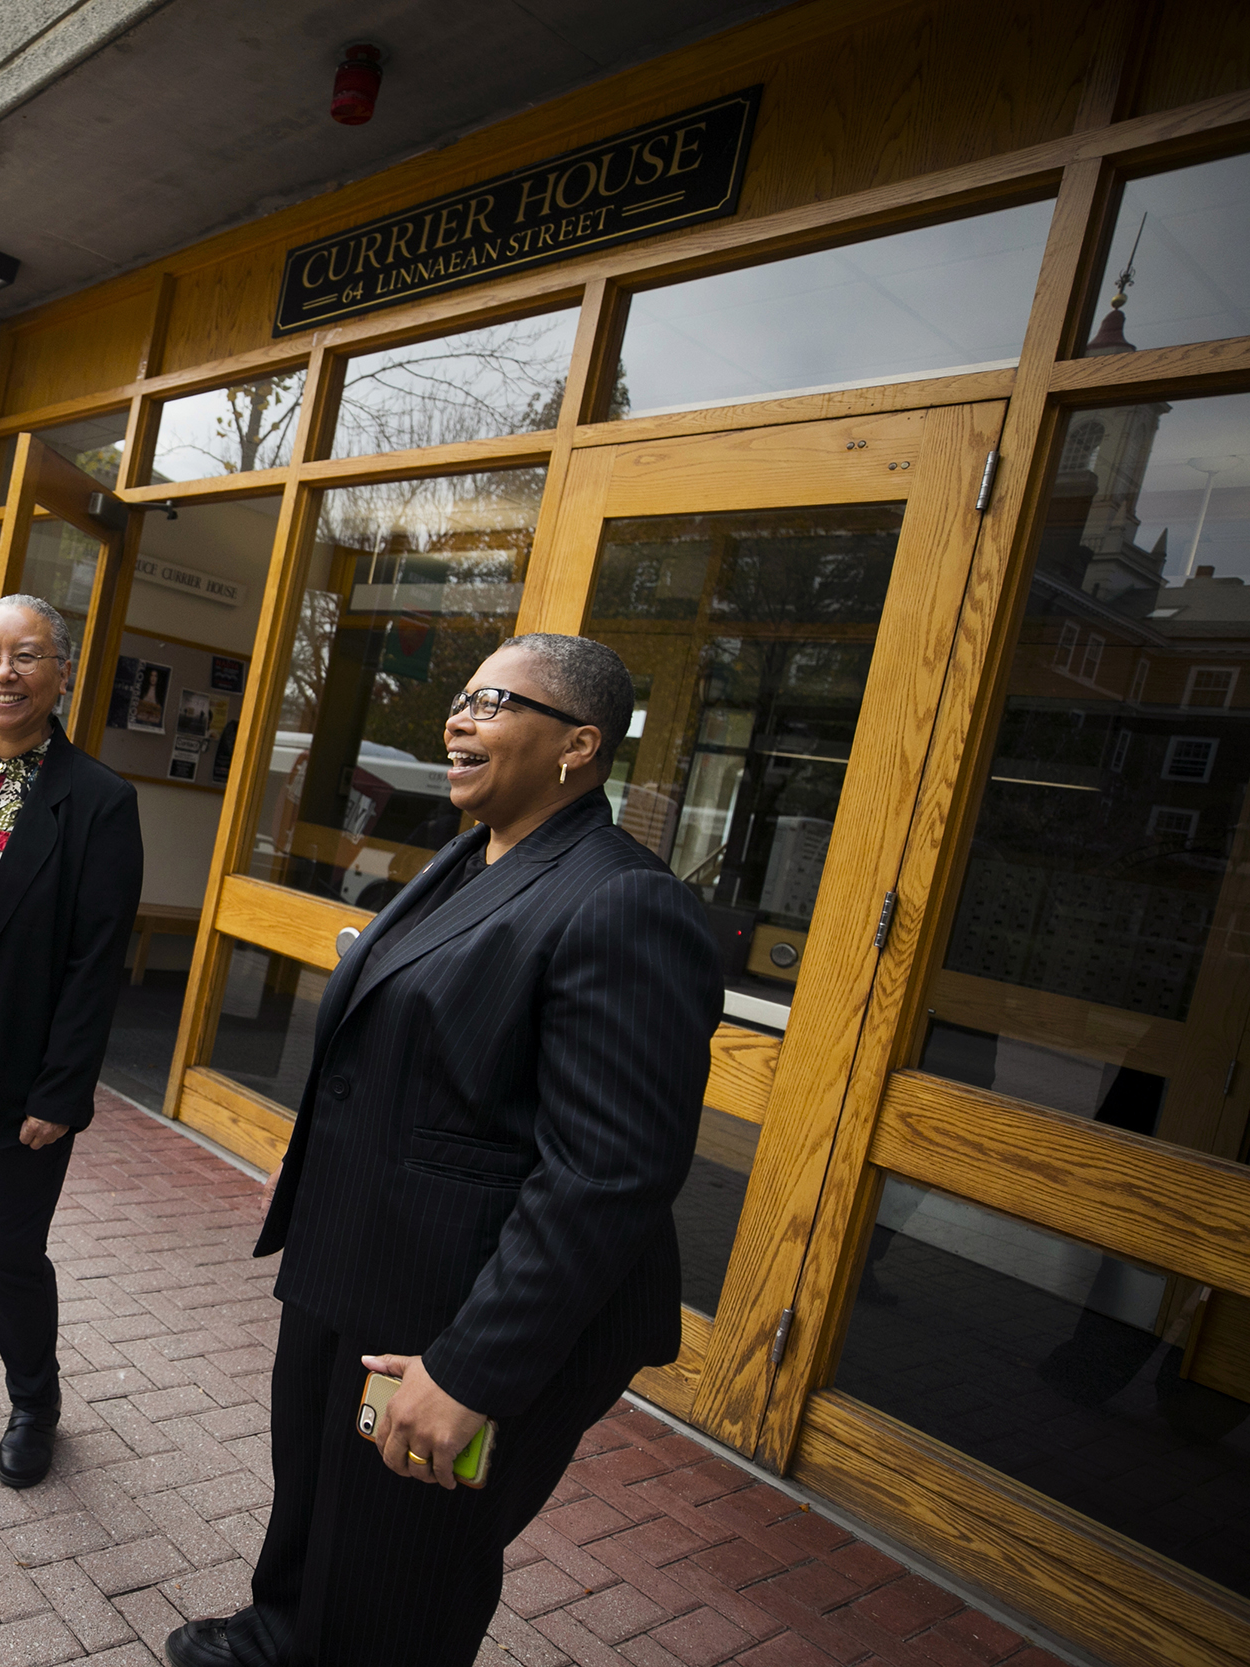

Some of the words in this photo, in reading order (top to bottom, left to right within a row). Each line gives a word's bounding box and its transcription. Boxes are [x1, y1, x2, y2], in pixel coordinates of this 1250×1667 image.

[302, 194, 495, 289] CURRIER
[514, 122, 707, 223] HOUSE
[342, 282, 364, 304] 64
[376, 238, 502, 294] LINNAEAN
[506, 205, 615, 256] STREET
[161, 567, 202, 590] CURRIER
[206, 579, 238, 600] HOUSE
